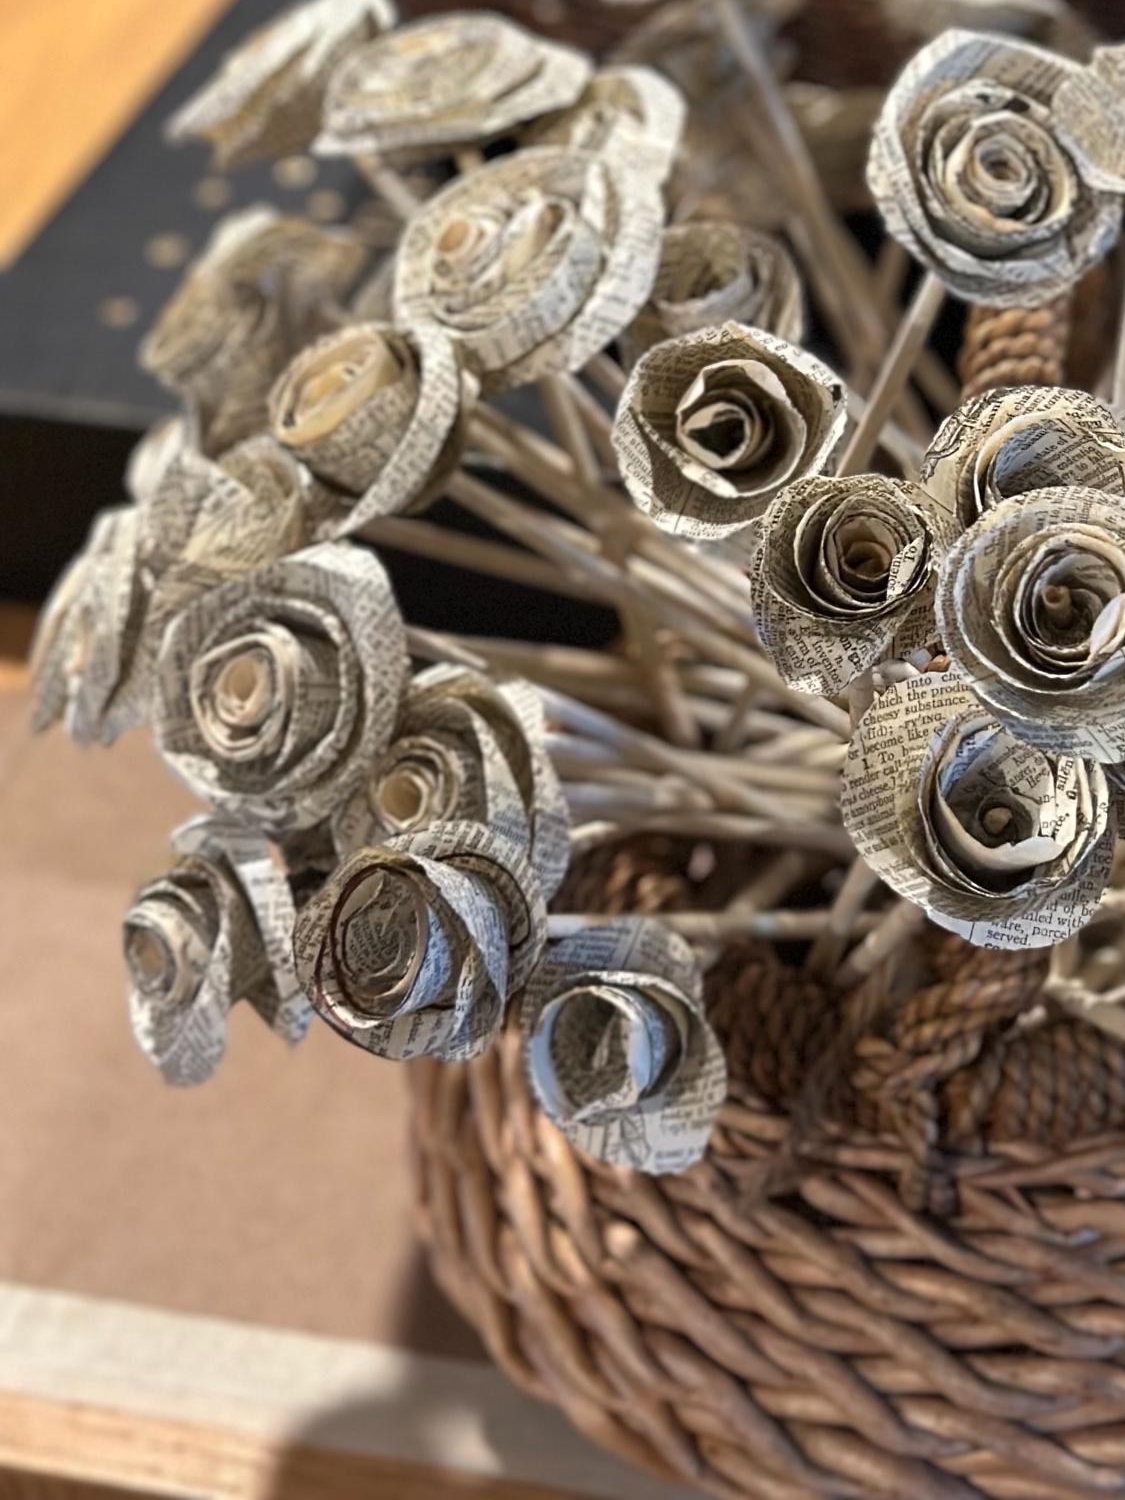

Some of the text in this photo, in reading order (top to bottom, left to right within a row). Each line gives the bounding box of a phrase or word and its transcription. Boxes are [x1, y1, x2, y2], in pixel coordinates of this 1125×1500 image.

[903, 544, 918, 563] To
[906, 676, 933, 690] into
[906, 688, 928, 702] the
[904, 694, 970, 716] substance.
[861, 734, 904, 756] become
[906, 726, 929, 742] like
[877, 750, 895, 765] To
[1063, 902, 1077, 918] of
[1057, 916, 1086, 929] with
[986, 928, 1032, 946] served.
